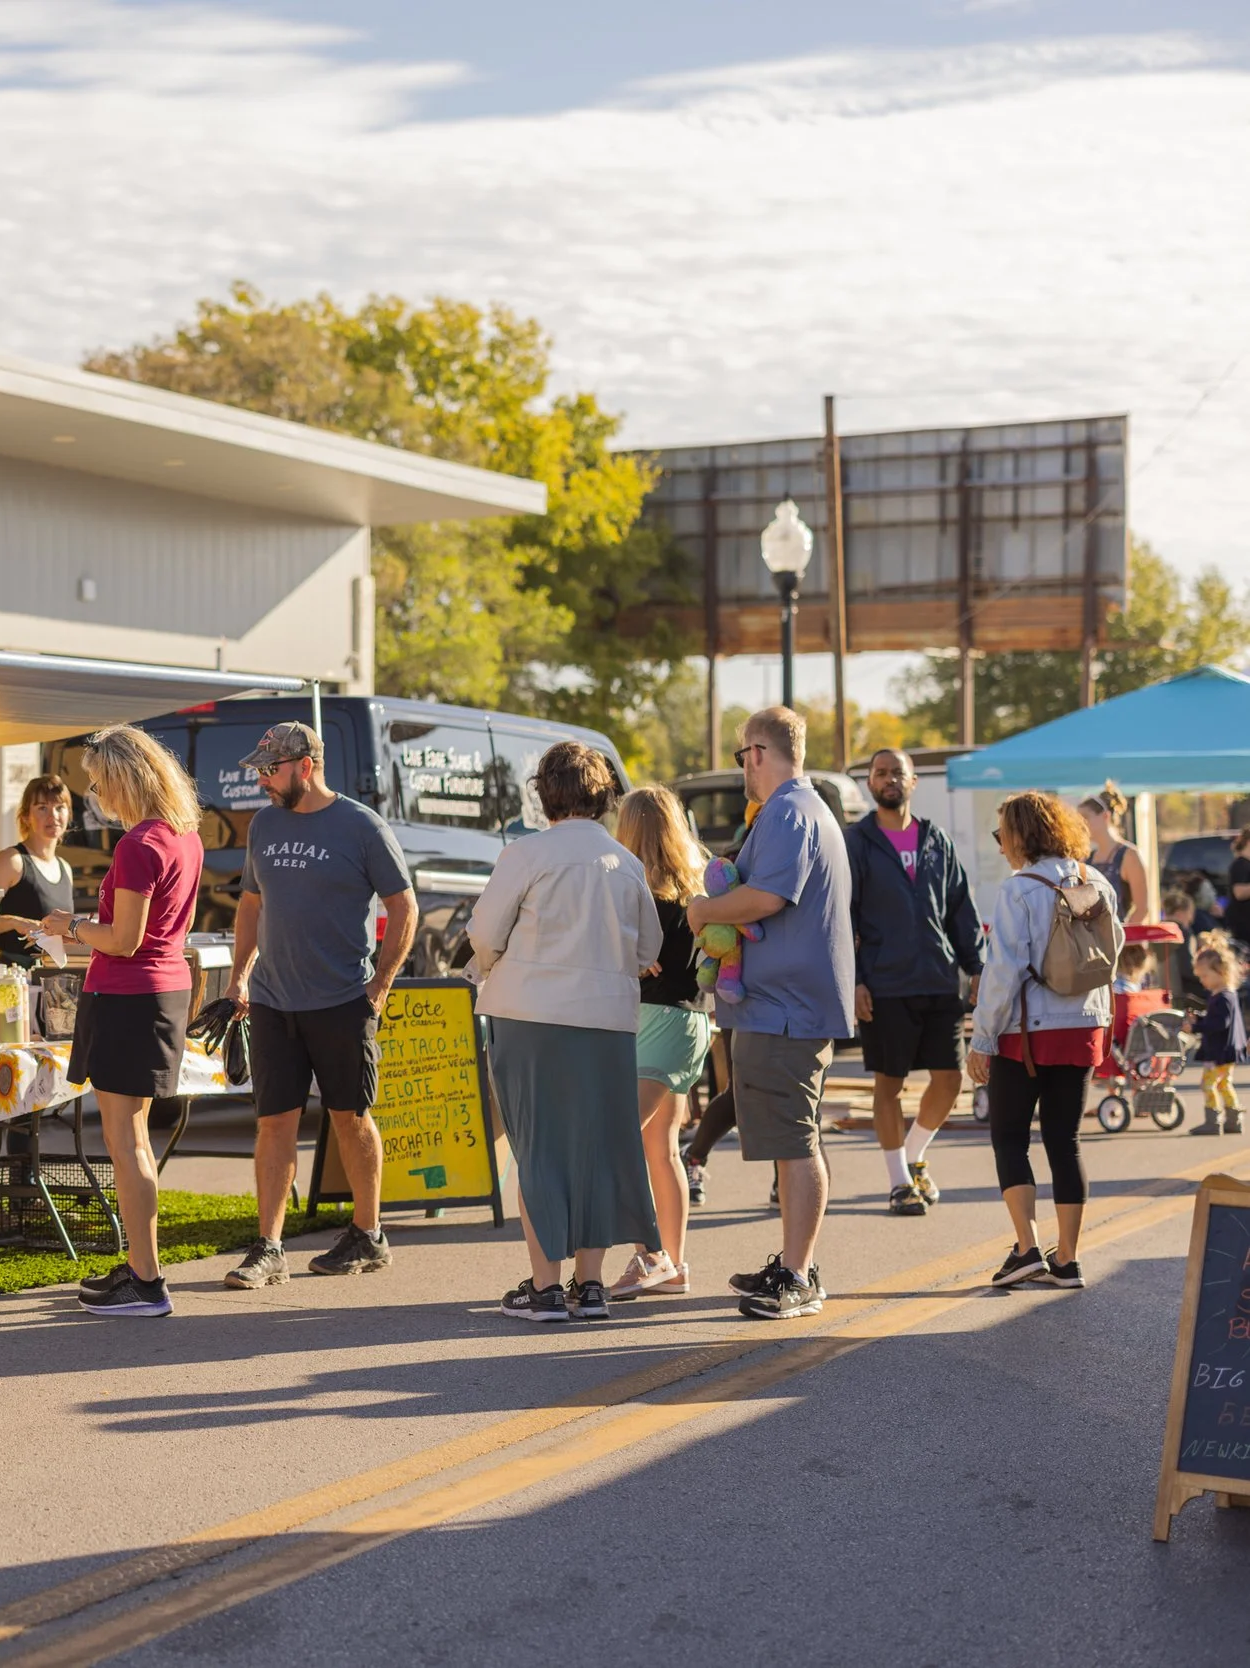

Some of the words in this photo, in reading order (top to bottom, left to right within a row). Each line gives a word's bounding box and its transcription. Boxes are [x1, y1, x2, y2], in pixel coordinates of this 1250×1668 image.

[273, 858, 307, 869] BEER
[385, 993, 445, 1020] Elote
[409, 1037, 447, 1056] TACO
[448, 1058, 477, 1068] VEGAN
[383, 1077, 434, 1101] ELOTE
[383, 1131, 443, 1156] ORCHATA
[1193, 1363, 1246, 1389] BIG
